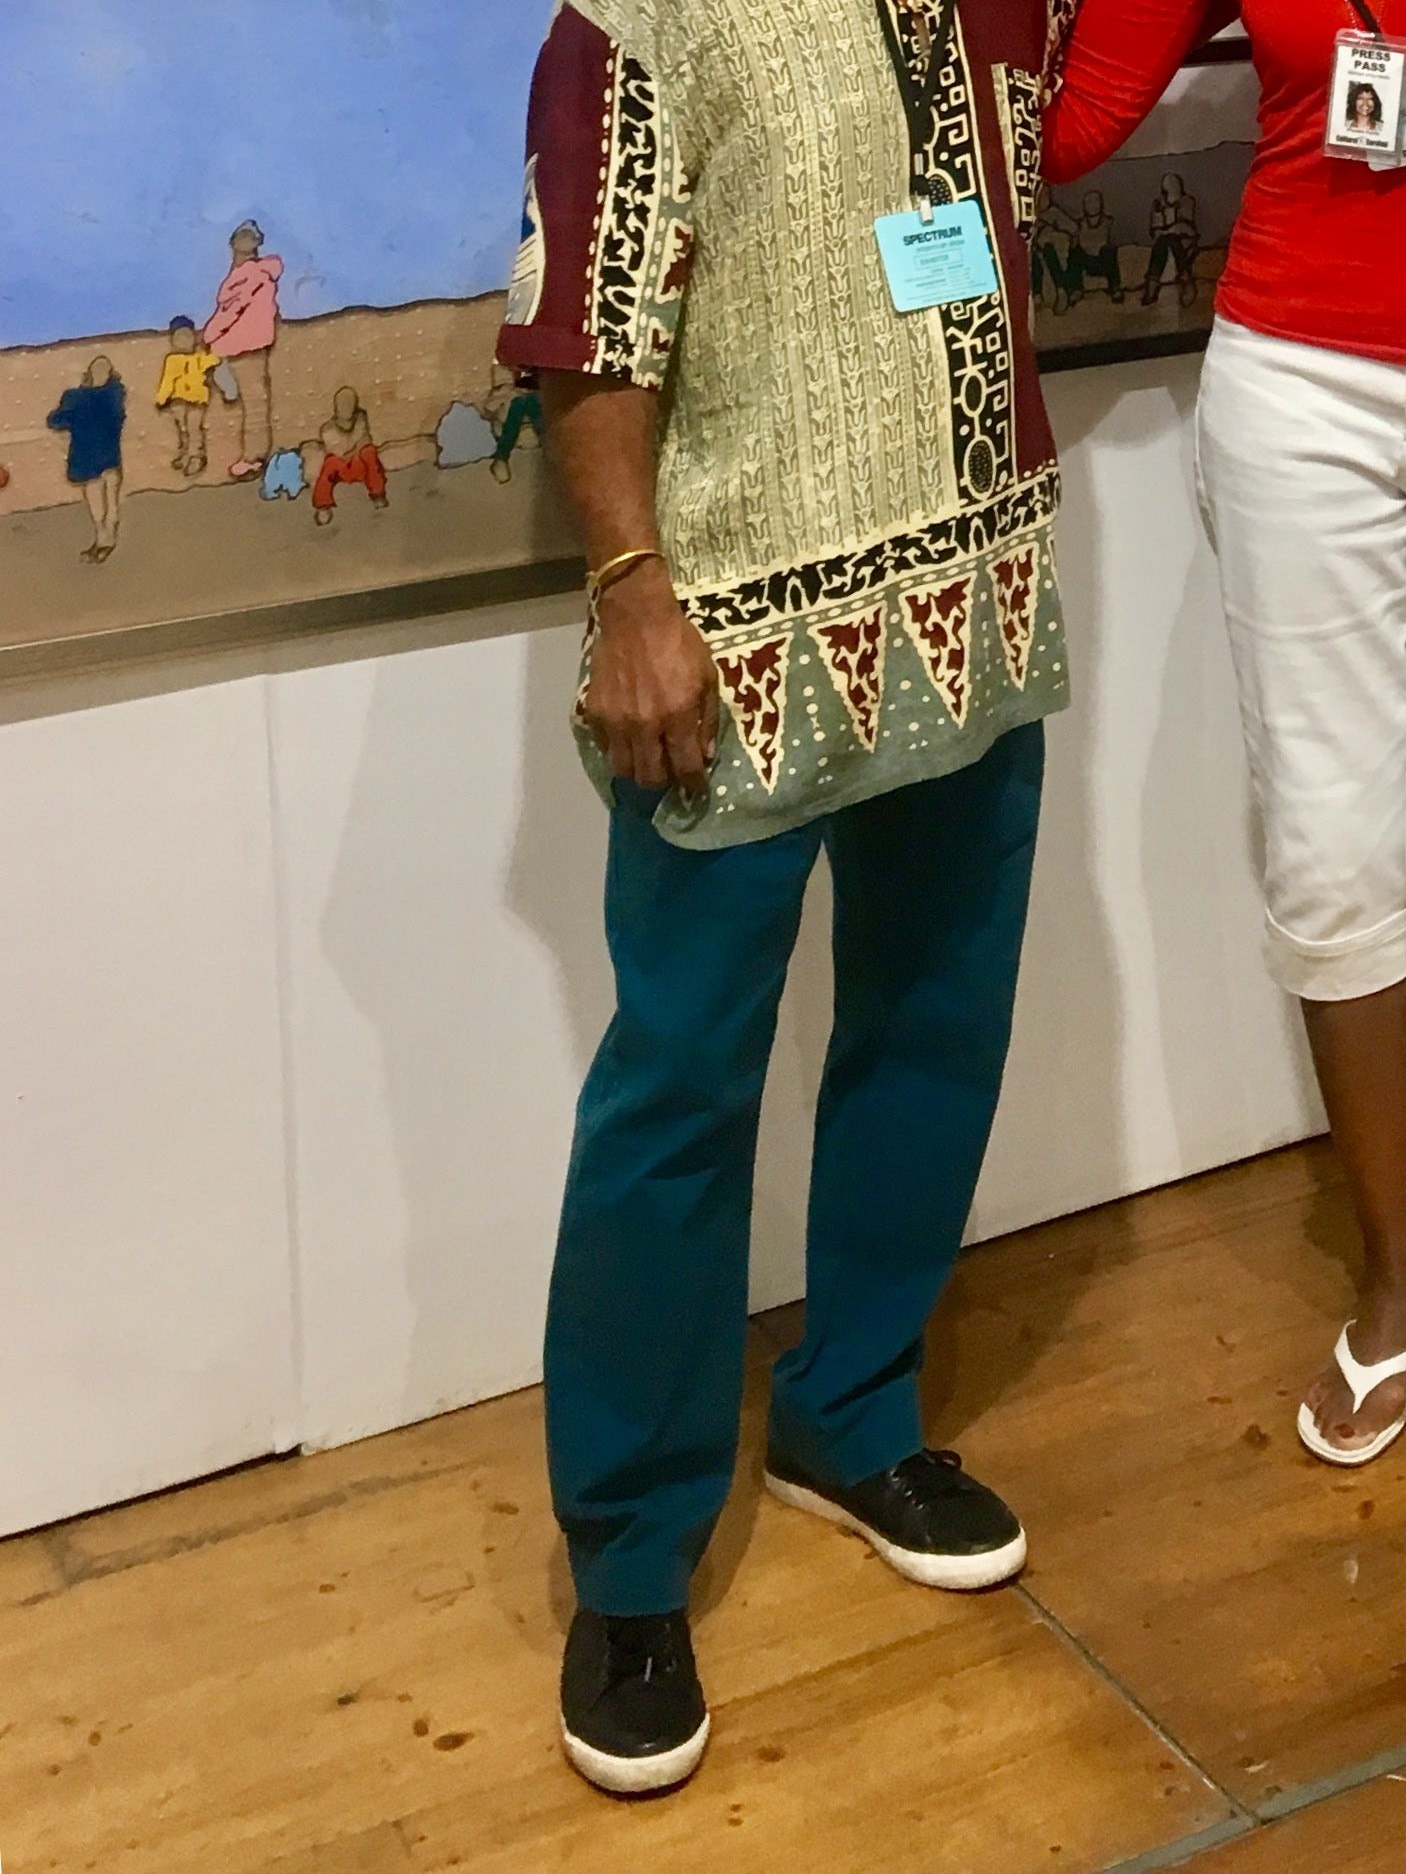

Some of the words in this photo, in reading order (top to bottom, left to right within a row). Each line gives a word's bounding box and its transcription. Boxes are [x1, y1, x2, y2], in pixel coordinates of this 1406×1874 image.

[1351, 47, 1391, 62] PRESS
[1354, 60, 1386, 73] PASS
[903, 226, 962, 246] SPECTRUM
